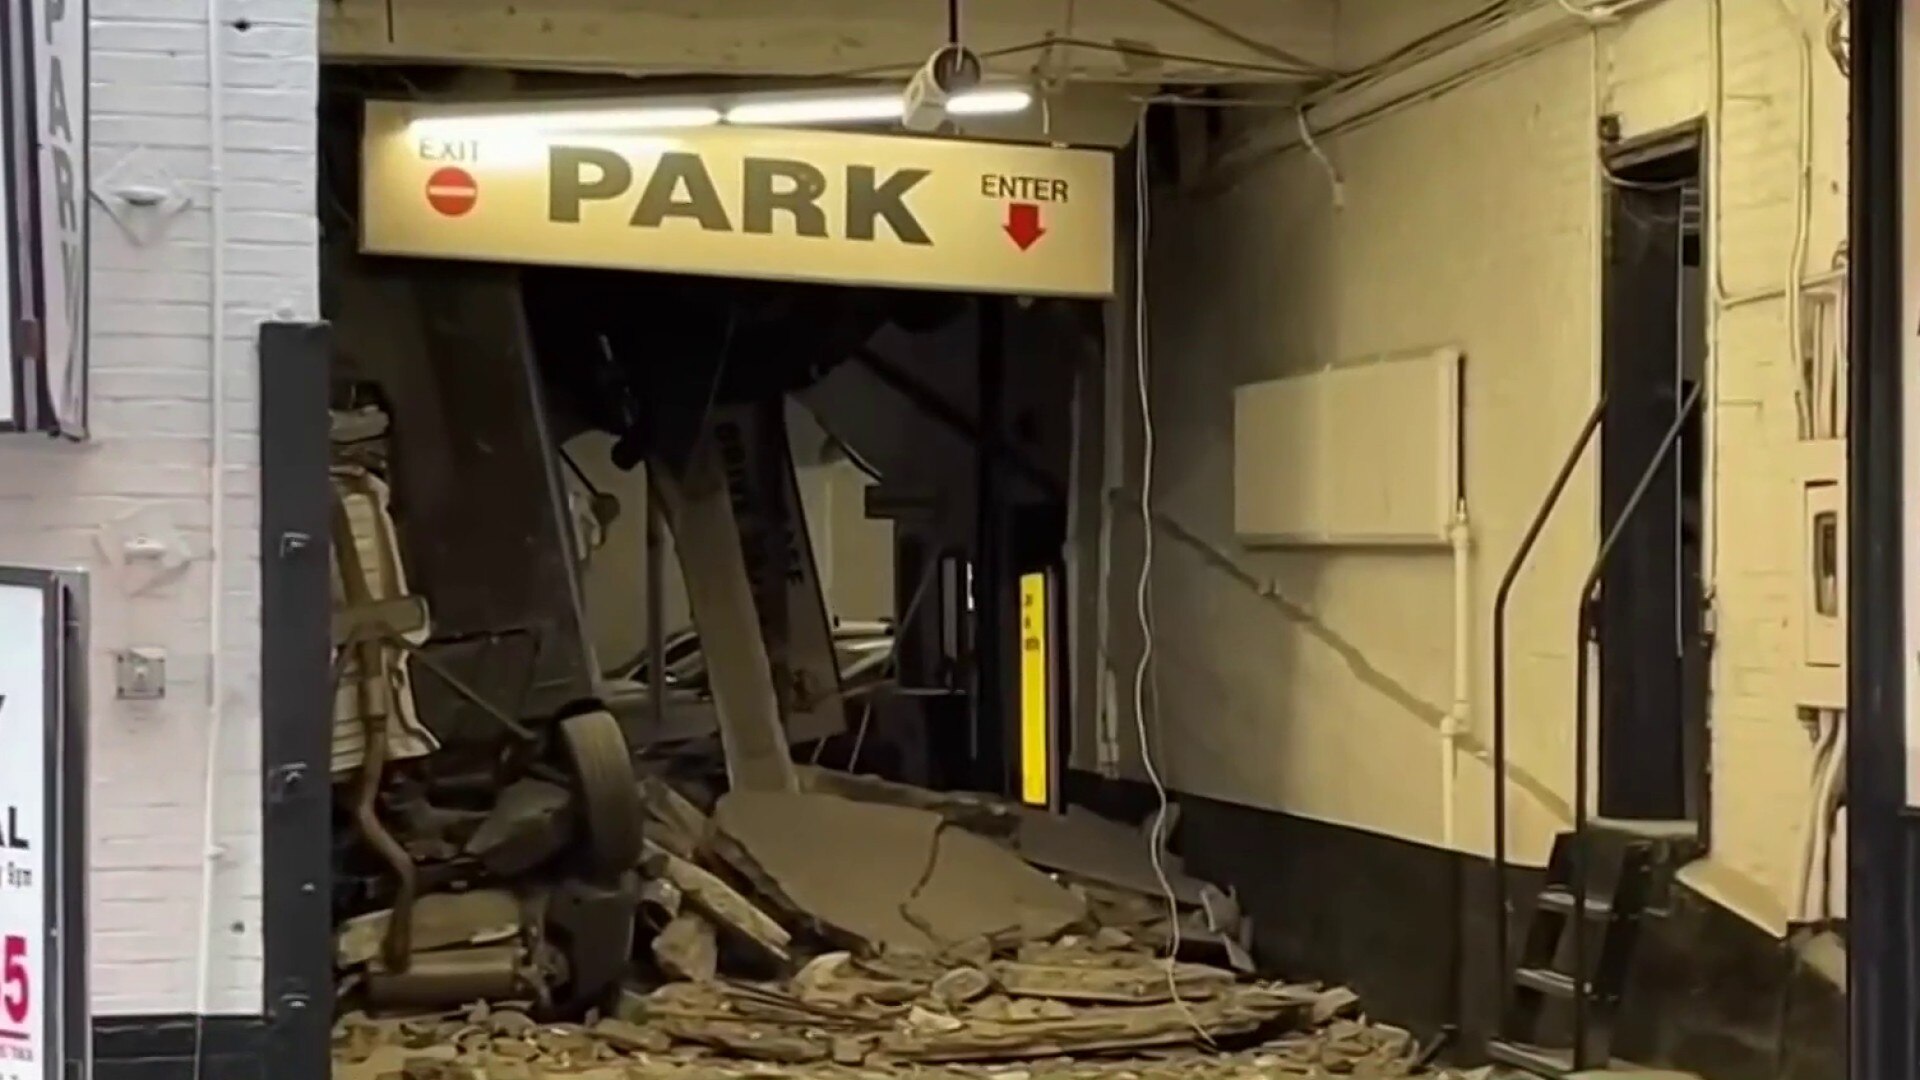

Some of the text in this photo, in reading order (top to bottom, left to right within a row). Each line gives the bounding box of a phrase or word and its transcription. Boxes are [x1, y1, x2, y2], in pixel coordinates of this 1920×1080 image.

[420, 138, 479, 162] EXIT
[548, 145, 934, 246] PARK
[981, 175, 1068, 203] ENTER
[0, 806, 30, 849] L
[0, 935, 29, 1024] 5
